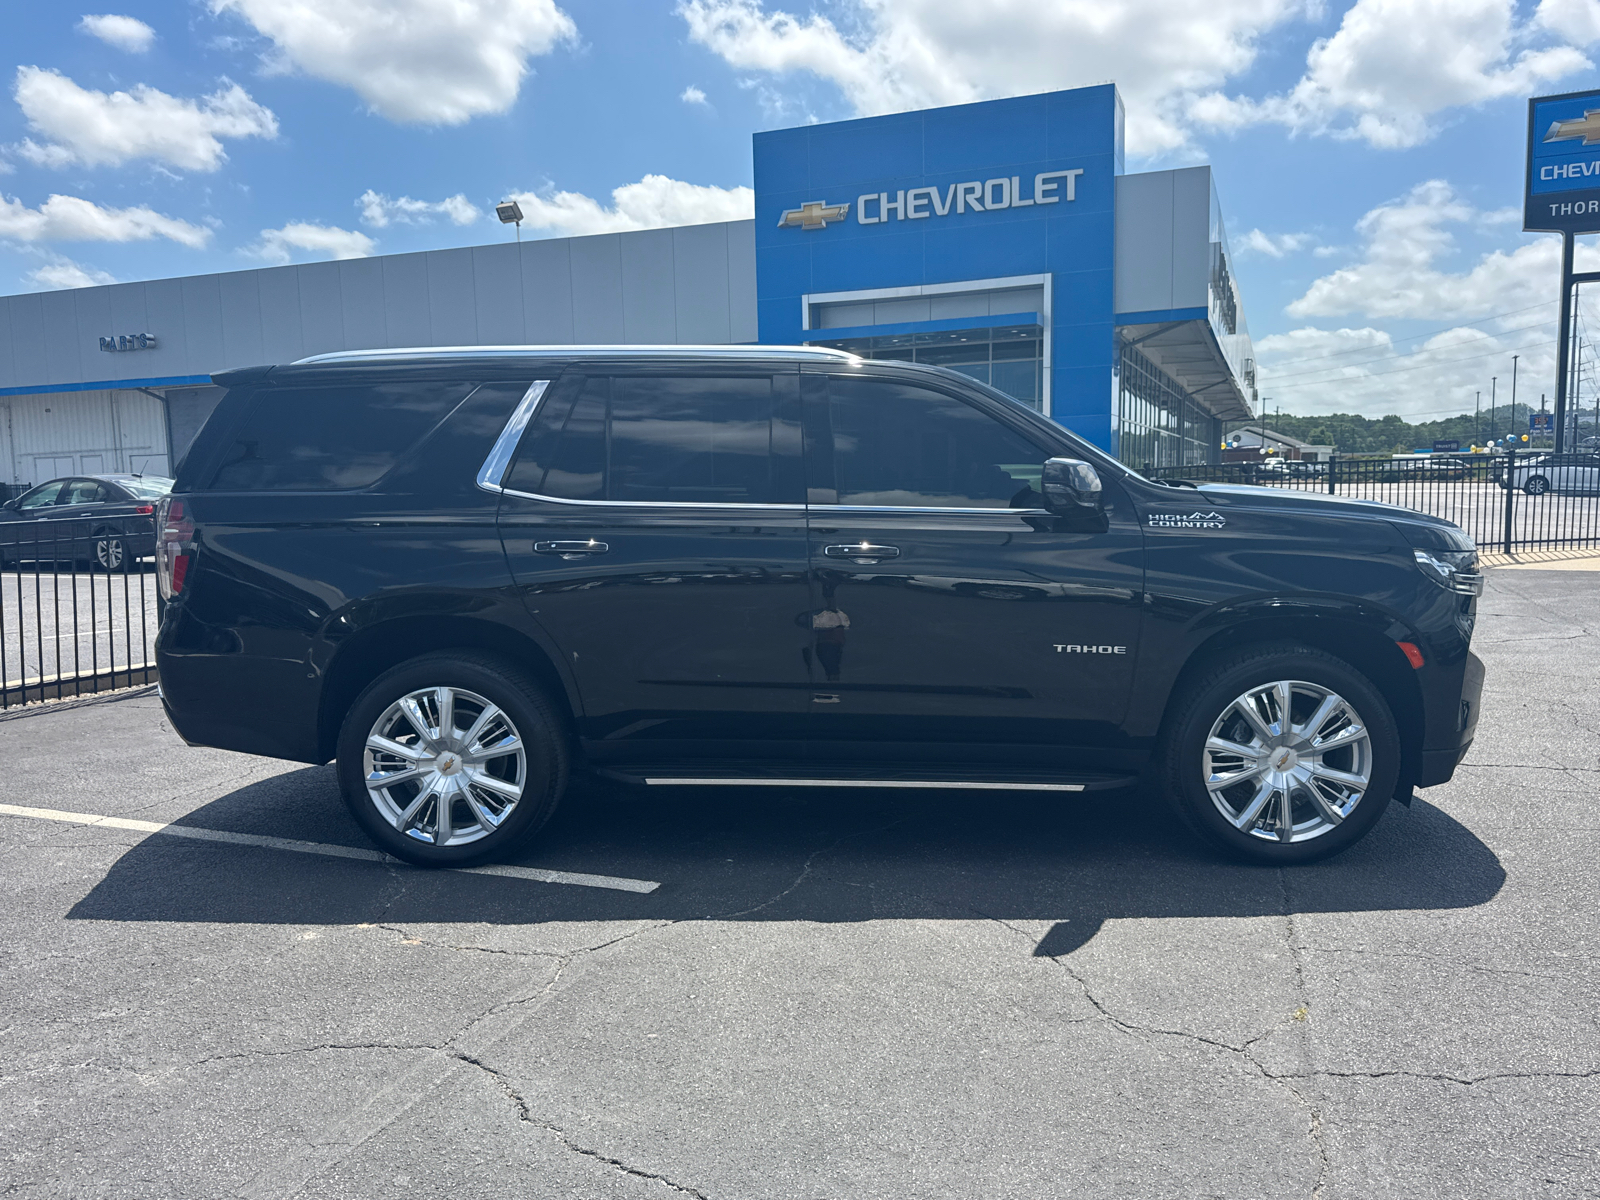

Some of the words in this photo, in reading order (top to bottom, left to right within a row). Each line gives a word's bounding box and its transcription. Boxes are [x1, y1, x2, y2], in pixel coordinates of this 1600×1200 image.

[857, 168, 1084, 225] CHEVROLET
[1549, 200, 1599, 216] THOR
[99, 333, 150, 351] PARTS
[1148, 520, 1226, 529] COUNTRY
[1053, 644, 1127, 655] TAHOE
